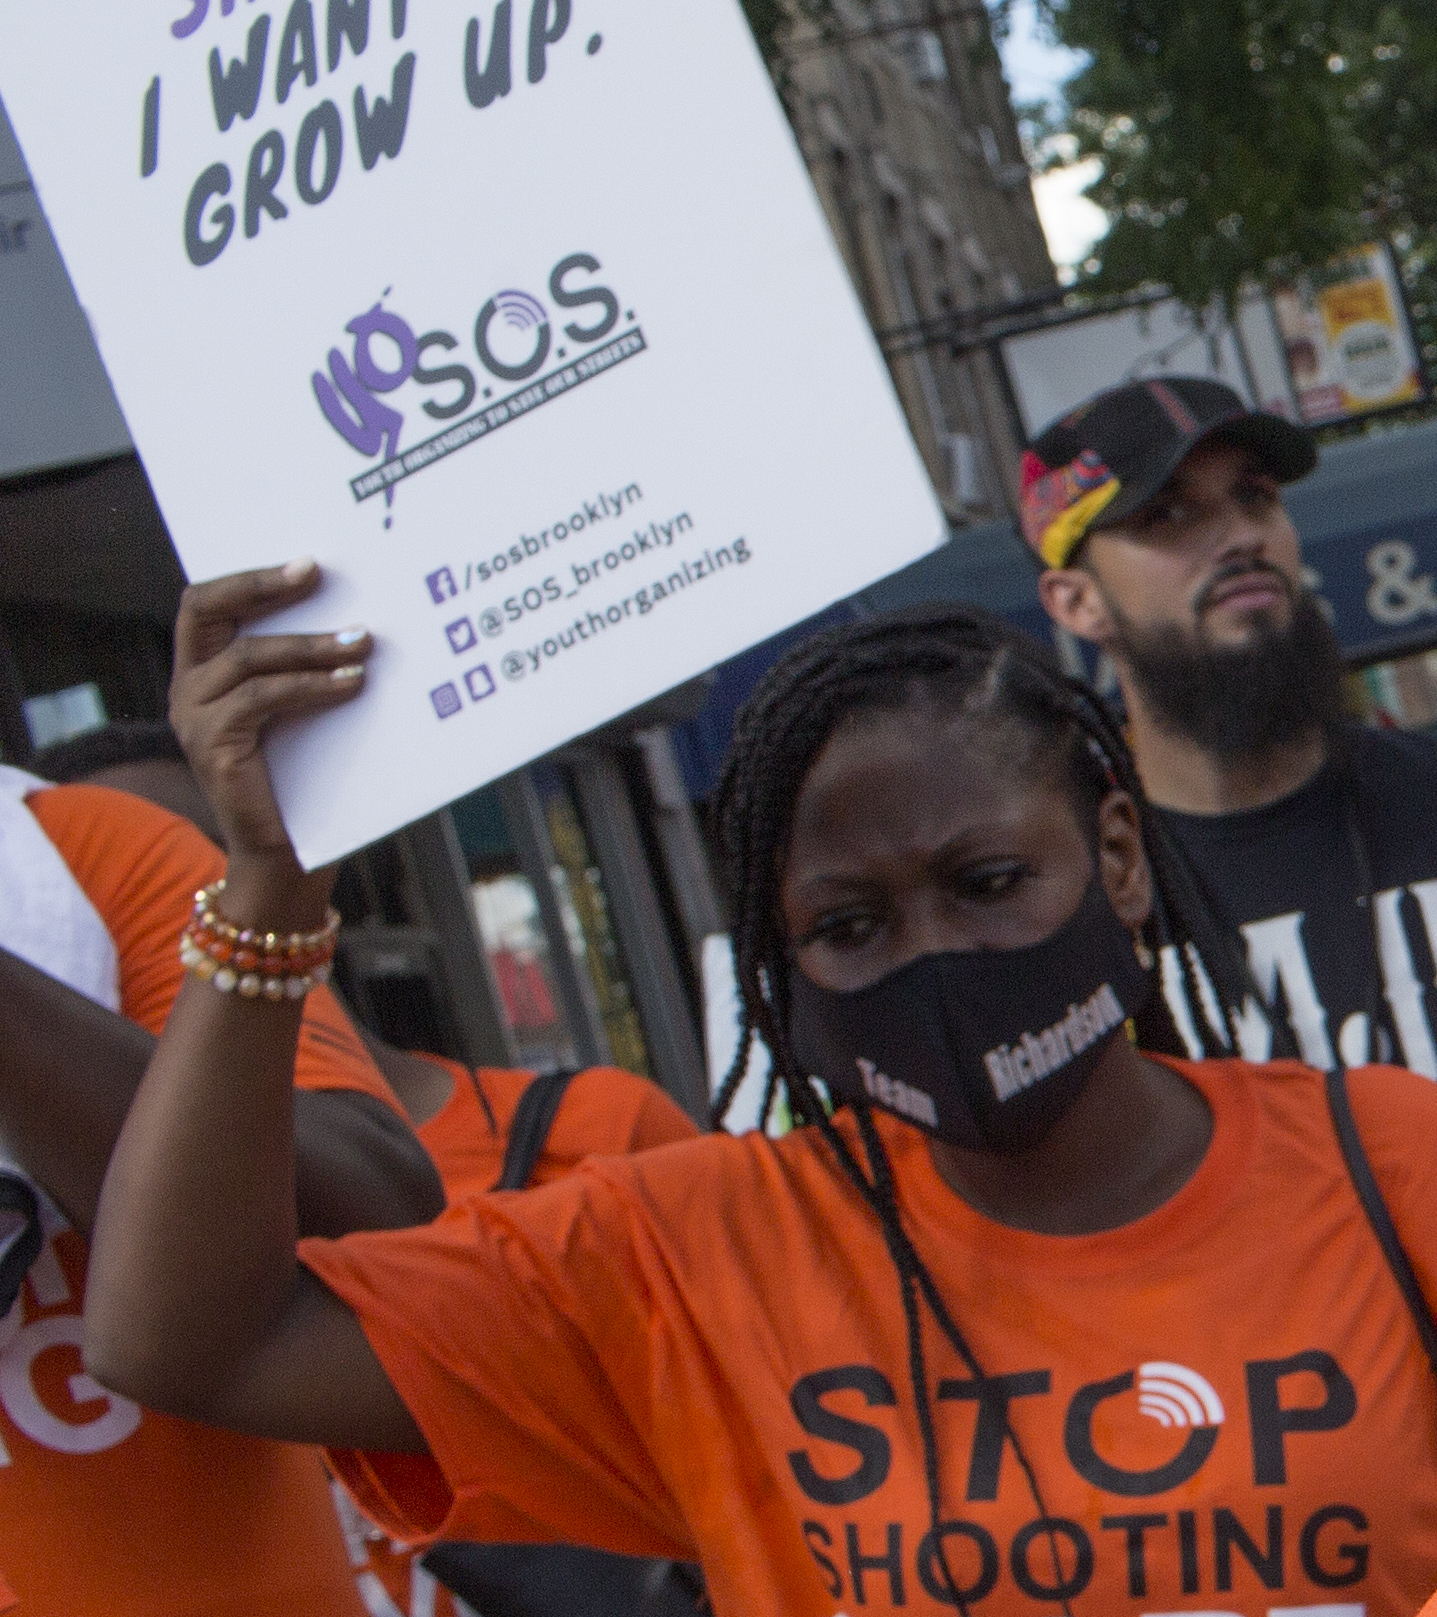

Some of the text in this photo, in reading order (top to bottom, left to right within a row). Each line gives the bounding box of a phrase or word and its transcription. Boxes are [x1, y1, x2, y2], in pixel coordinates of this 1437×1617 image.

[140, 74, 161, 178] I
[183, 0, 602, 267] GROW UP.
[982, 982, 1126, 1103] Richardson
[786, 1348, 1359, 1506] STOP
[802, 1503, 1373, 1608] SHOOTING
